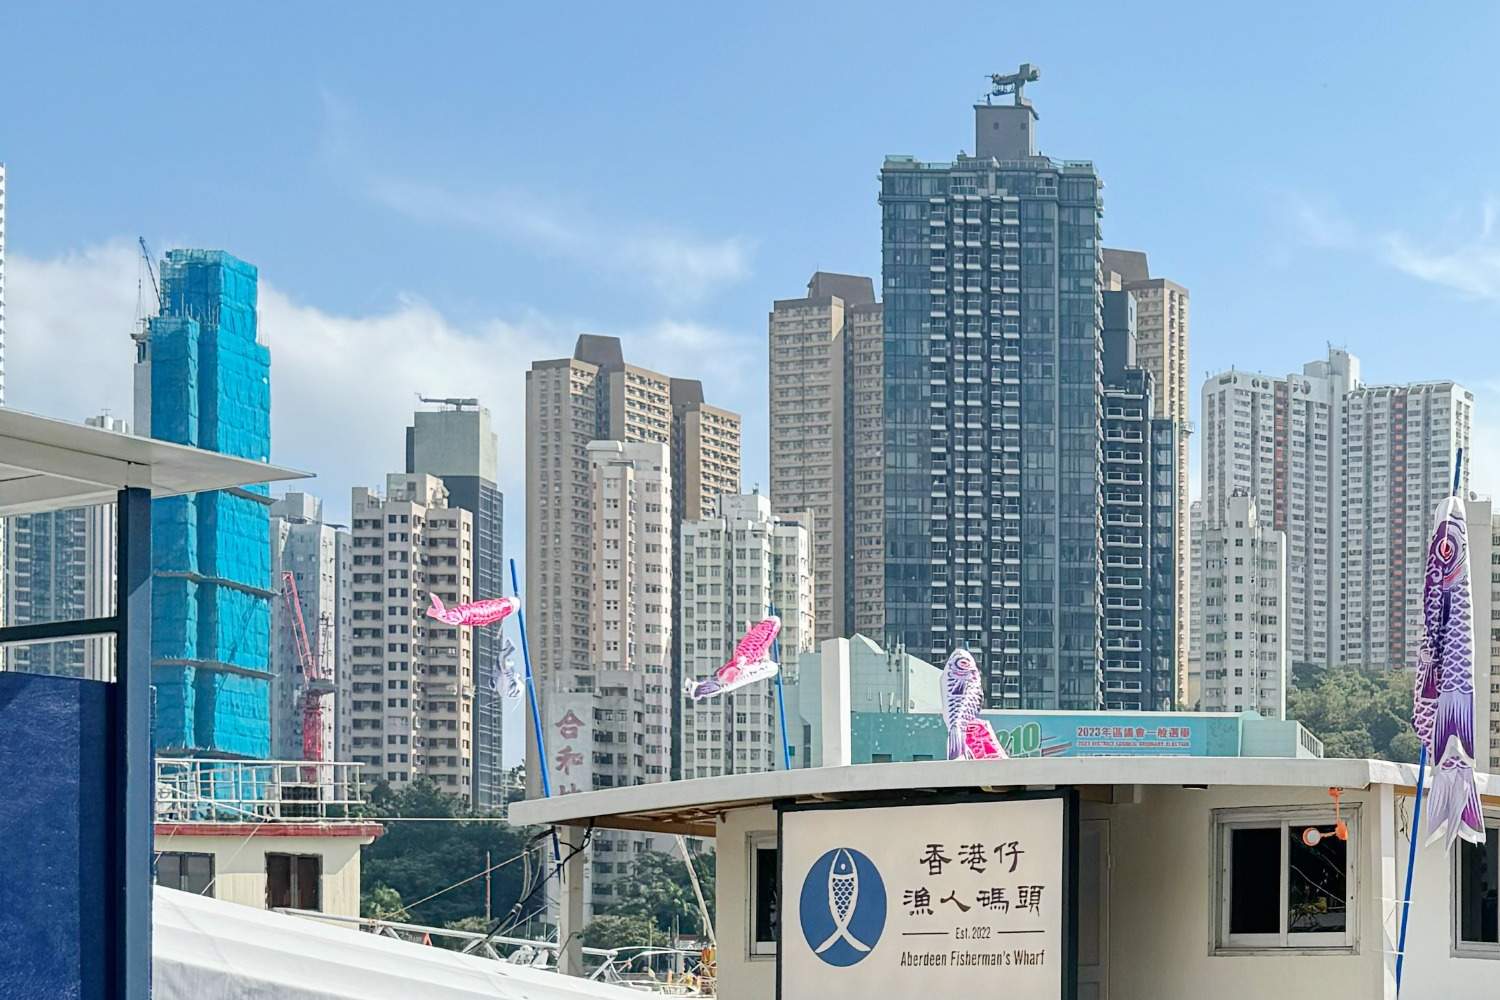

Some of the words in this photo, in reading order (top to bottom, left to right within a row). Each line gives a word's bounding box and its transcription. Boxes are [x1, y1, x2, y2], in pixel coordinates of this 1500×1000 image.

[920, 841, 1025, 875] 香港仔
[903, 885, 1045, 916] 漁人碼頭
[900, 951, 947, 966] Aberdeen
[950, 950, 1011, 966] Fisherman's
[1013, 948, 1045, 966] Wharf
